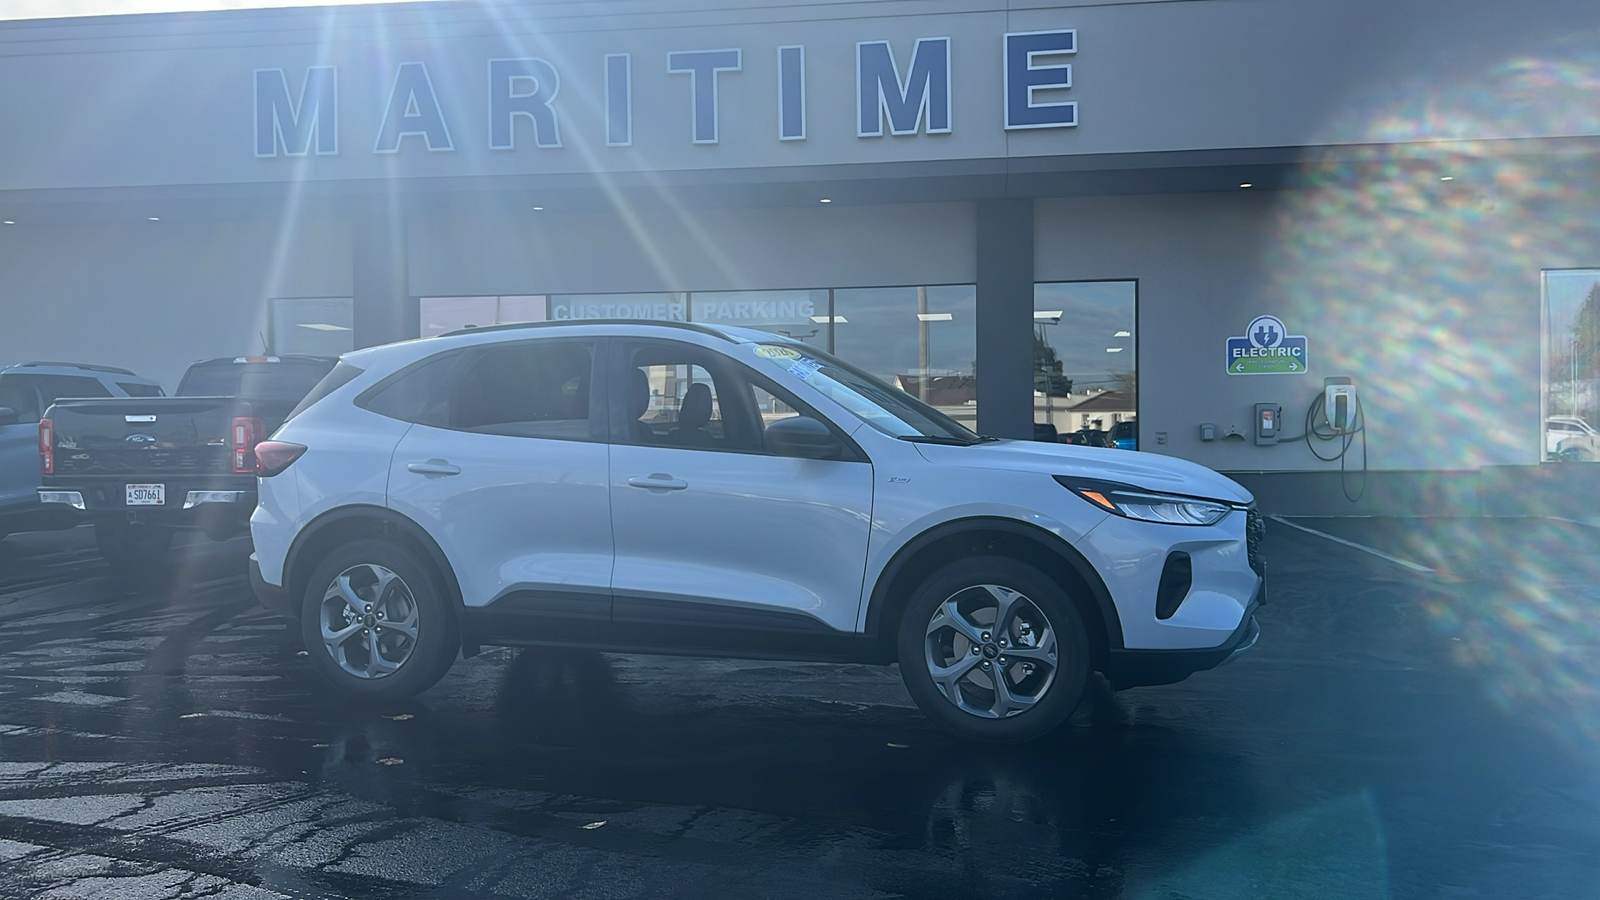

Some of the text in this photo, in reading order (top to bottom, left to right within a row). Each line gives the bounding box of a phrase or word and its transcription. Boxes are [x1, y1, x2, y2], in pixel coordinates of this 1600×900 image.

[252, 28, 1079, 159] MARITIME
[553, 299, 816, 321] CUSTOMER PARKING
[1232, 347, 1301, 358] ELECTRIC
